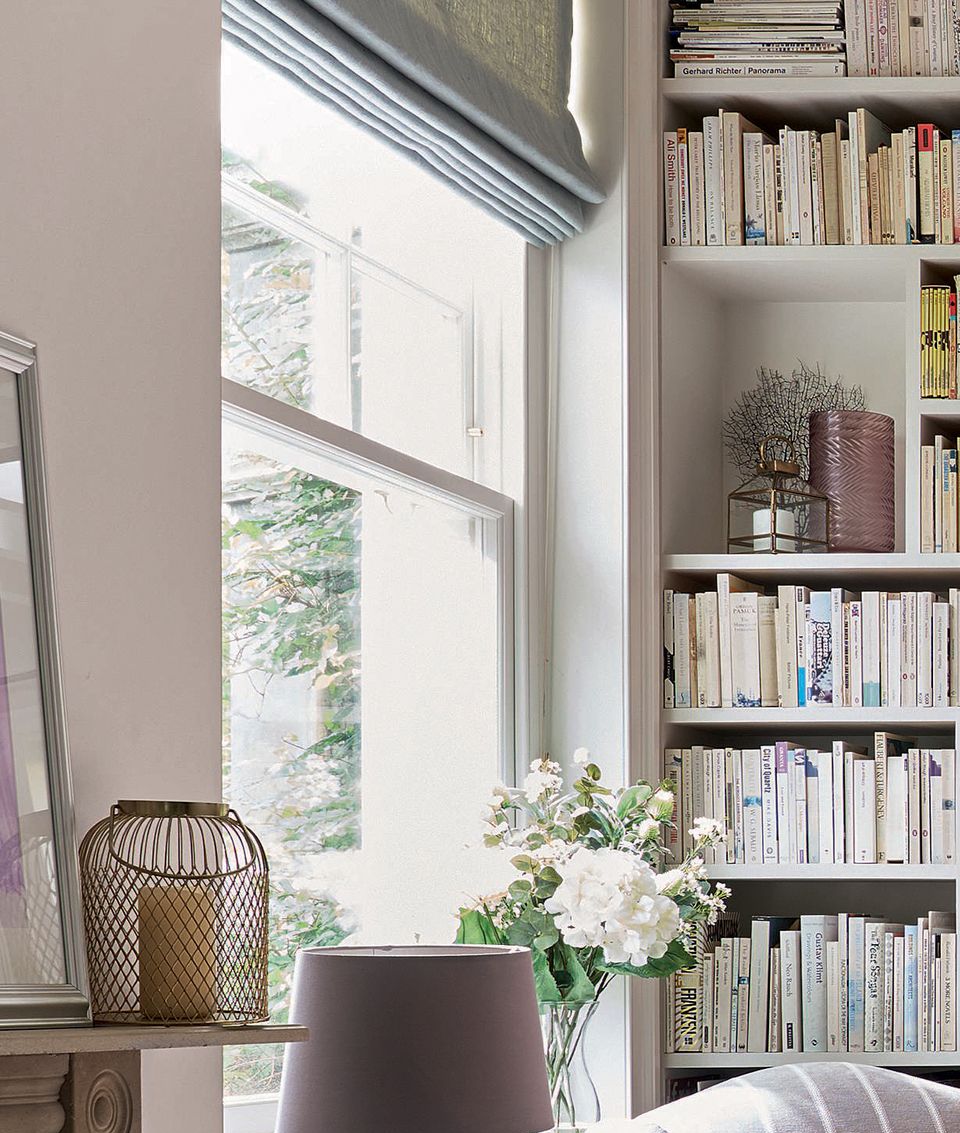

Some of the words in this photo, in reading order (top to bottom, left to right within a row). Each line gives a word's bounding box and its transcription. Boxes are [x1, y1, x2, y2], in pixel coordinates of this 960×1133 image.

[667, 154, 675, 181] Smith
[753, 164, 761, 189] Vargas
[669, 206, 674, 214] be
[763, 749, 771, 762] City
[876, 734, 885, 772] FLAUBERT
[763, 771, 771, 793] Quartz
[876, 779, 884, 821] TURGENEV
[681, 988, 697, 1034] FRANZEN
